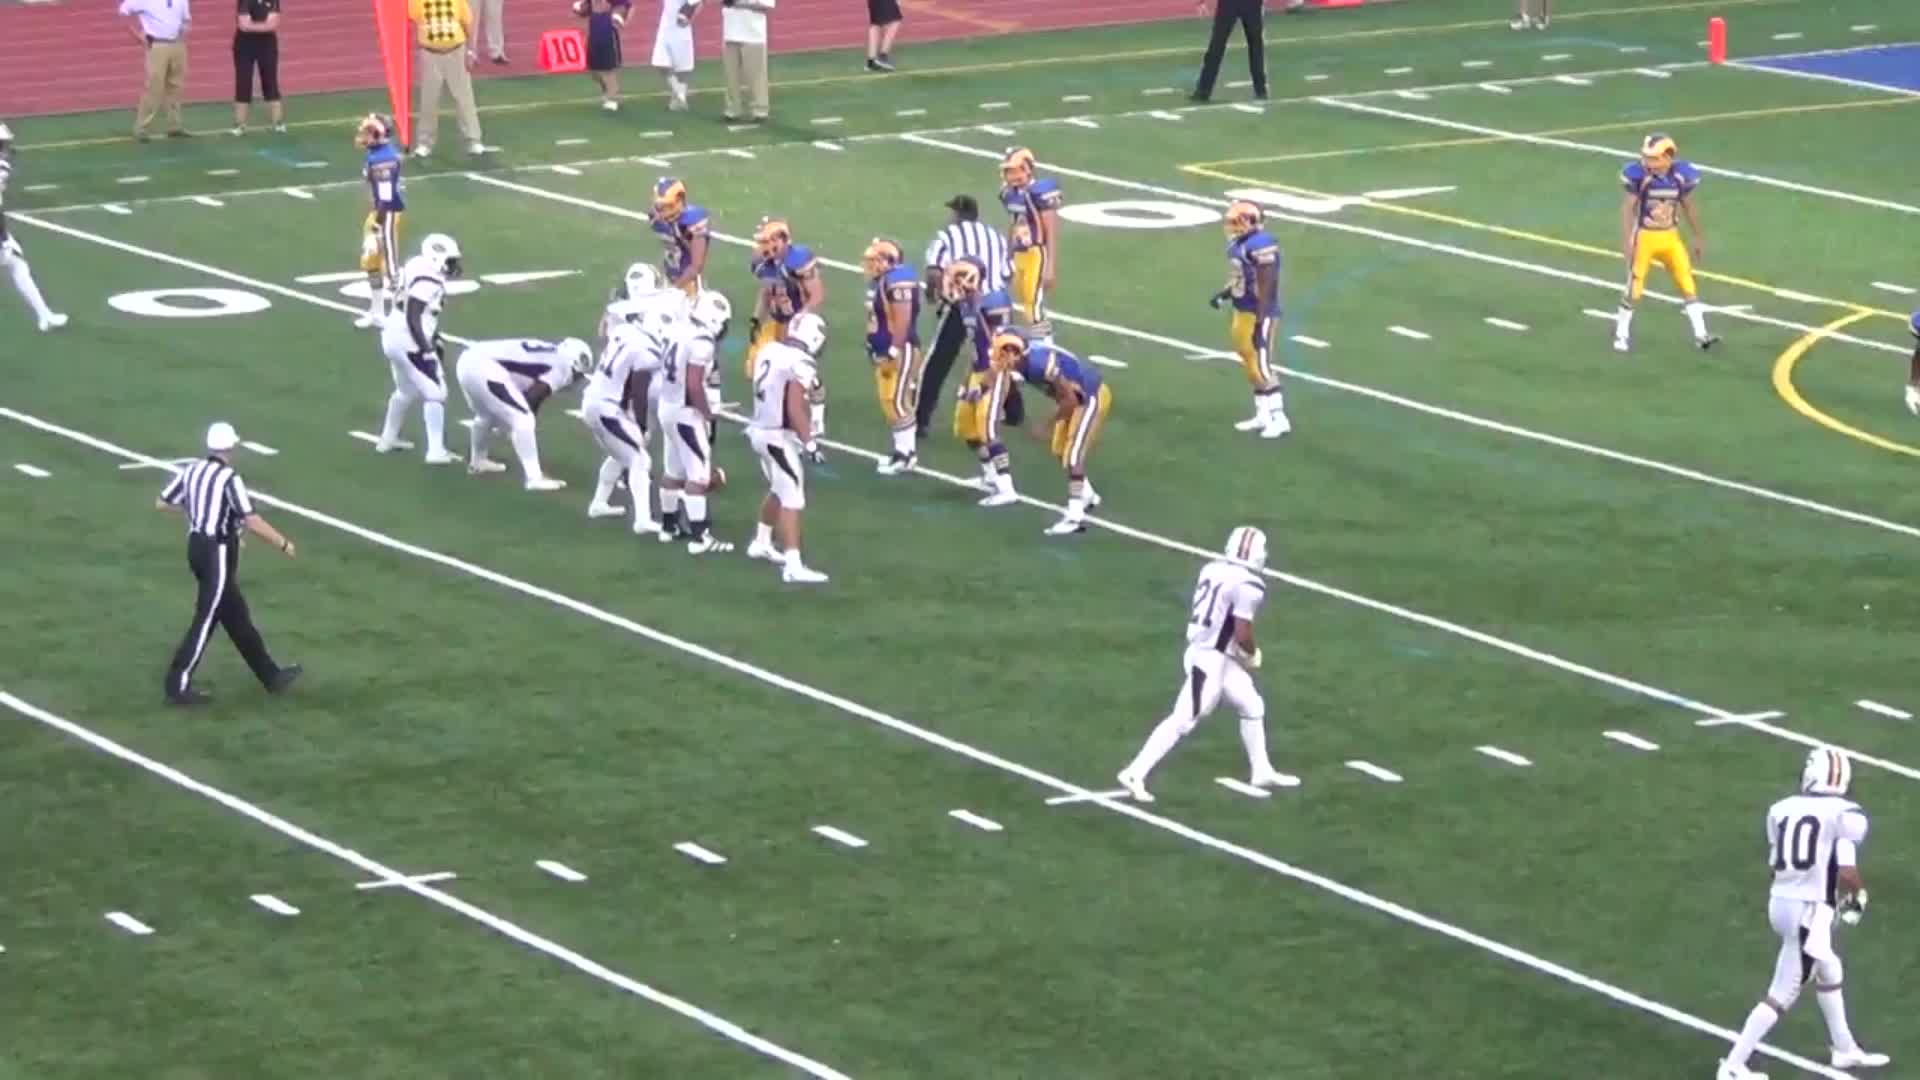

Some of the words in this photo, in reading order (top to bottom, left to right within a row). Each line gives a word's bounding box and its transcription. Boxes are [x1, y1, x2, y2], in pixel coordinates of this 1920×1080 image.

[551, 37, 580, 63] 10
[755, 359, 771, 403] 2
[1193, 578, 1224, 628] 21
[1774, 815, 1821, 871] 10
